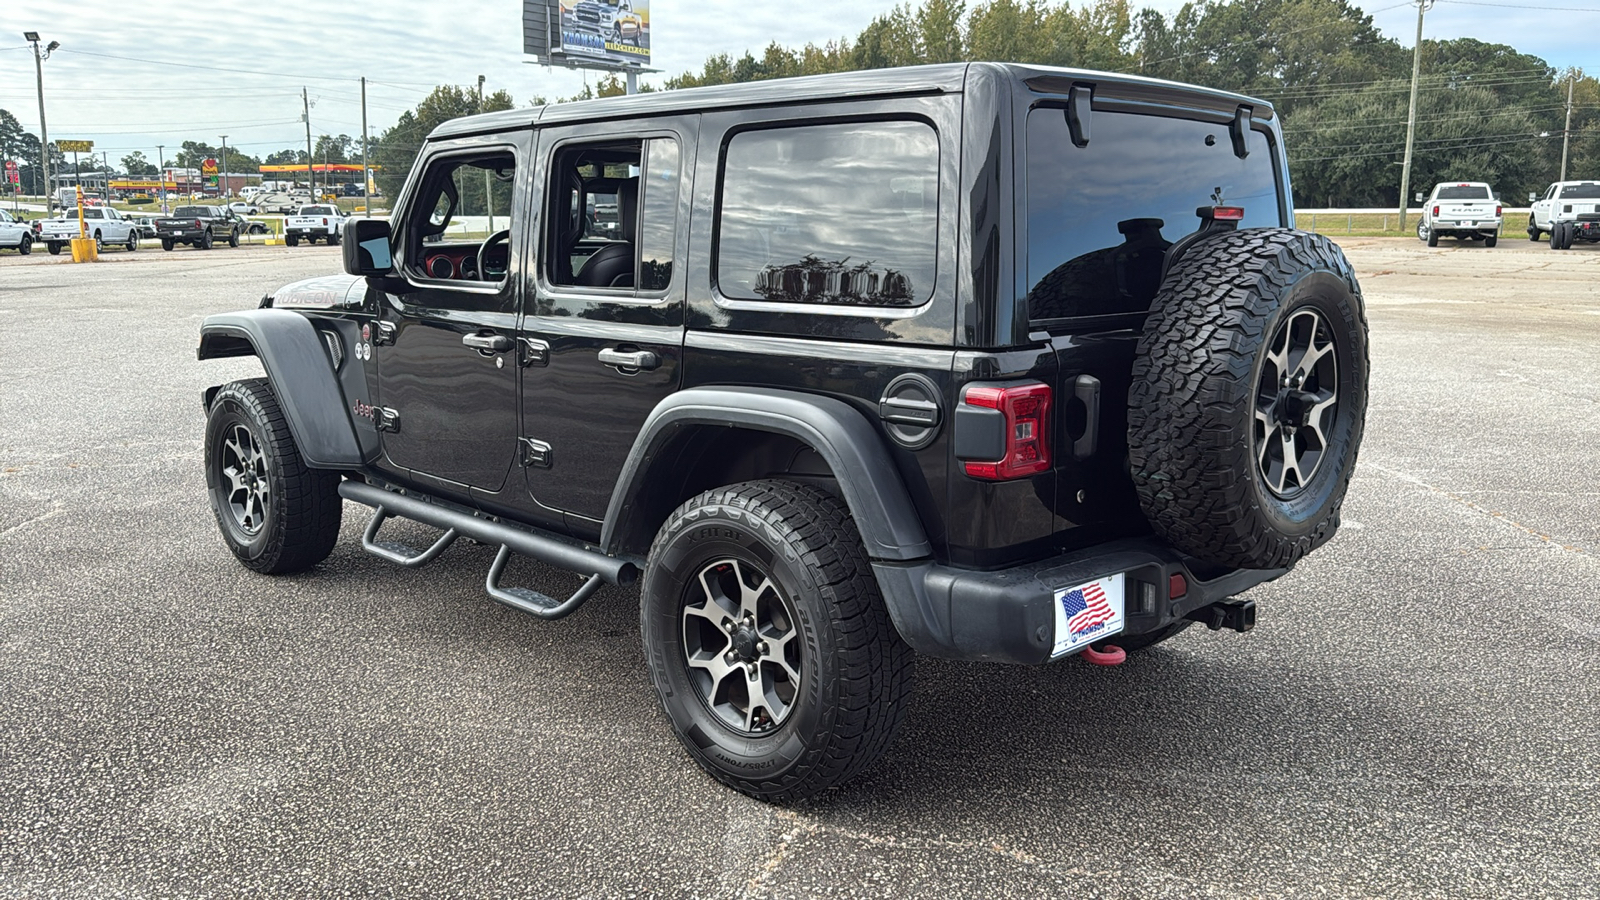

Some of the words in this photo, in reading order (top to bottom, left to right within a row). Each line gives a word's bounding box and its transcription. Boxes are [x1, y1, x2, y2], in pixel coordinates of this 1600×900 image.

[563, 31, 605, 49] THOMSON
[605, 42, 650, 55] JEEPCHEAP.COM
[275, 291, 338, 304] RUBICON
[353, 399, 375, 421] Jeep
[700, 527, 721, 539] FIT
[1079, 622, 1105, 638] THOMSON
[715, 752, 776, 770] LT285/70R17
